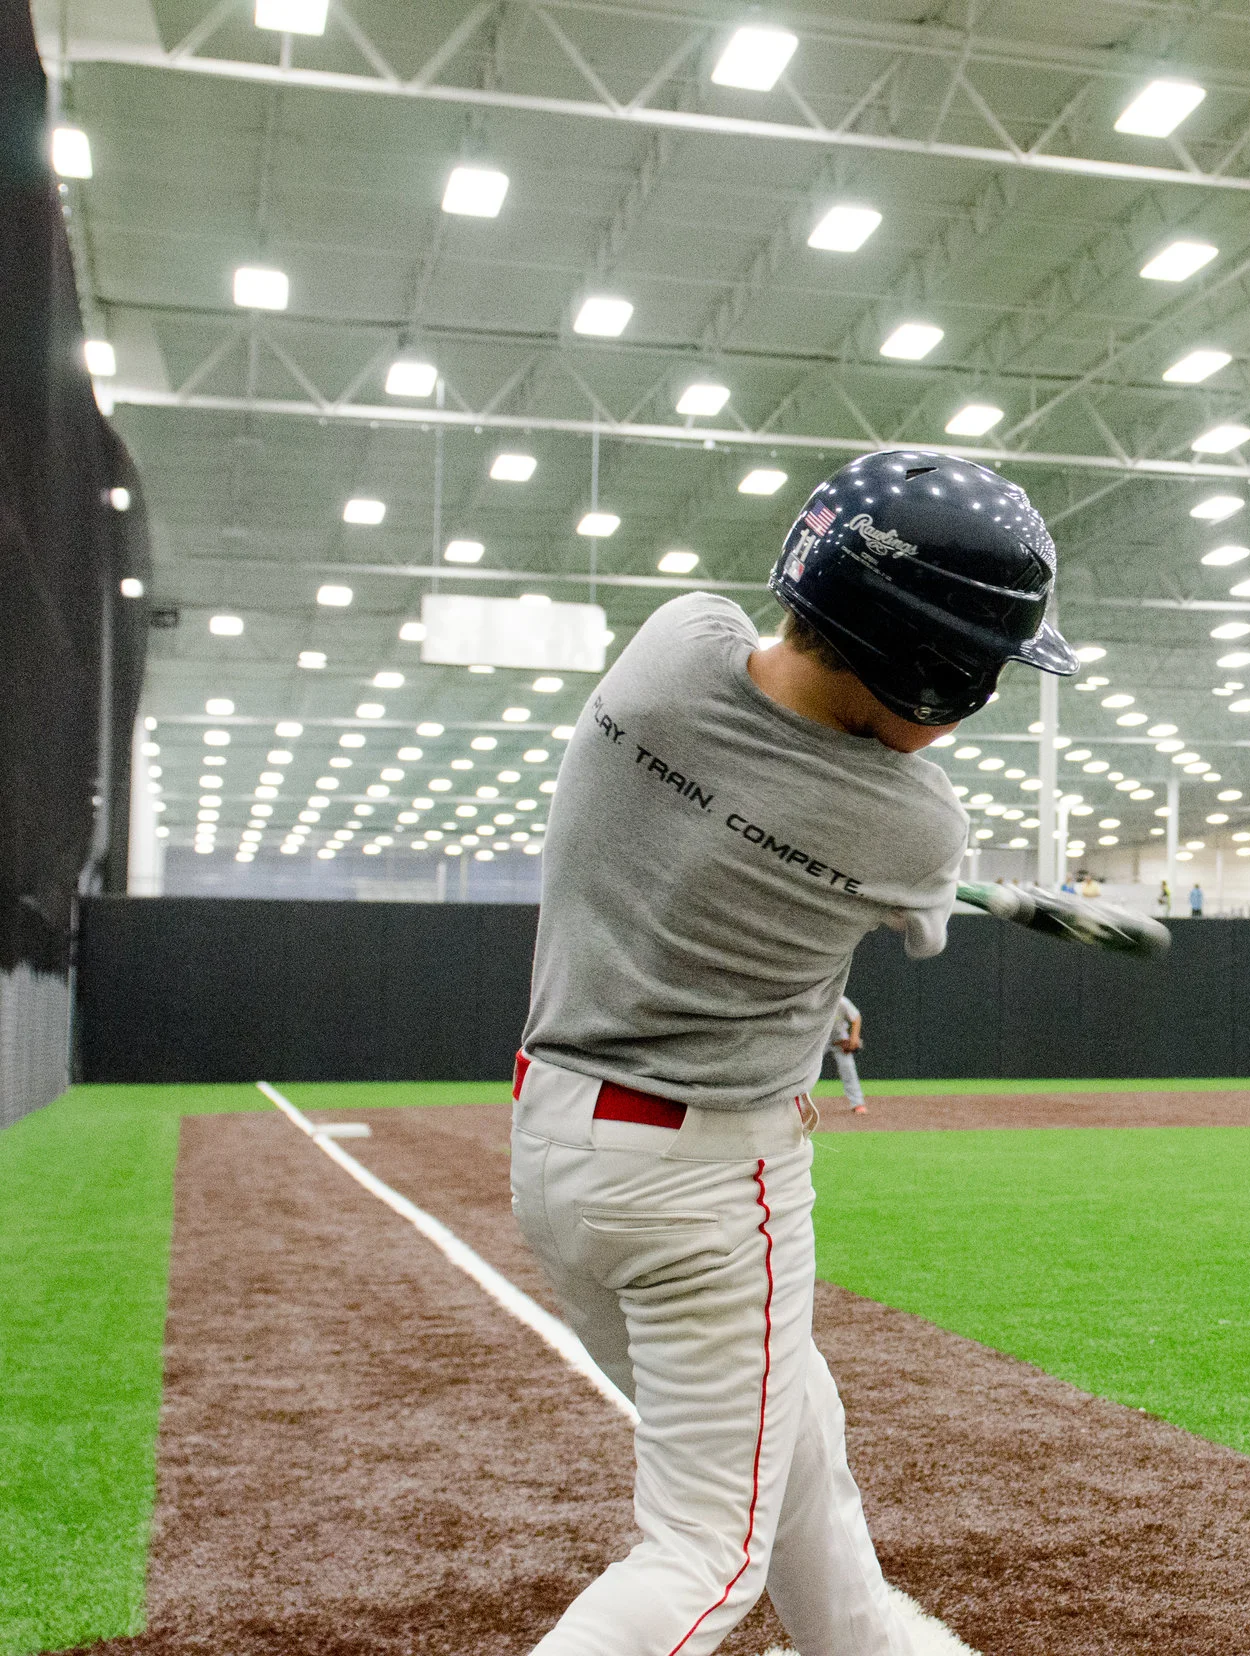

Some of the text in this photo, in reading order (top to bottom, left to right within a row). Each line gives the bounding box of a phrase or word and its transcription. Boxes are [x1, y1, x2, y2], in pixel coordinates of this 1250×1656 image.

[849, 513, 919, 559] Rawlings
[636, 744, 714, 813] TRAIN.
[726, 813, 864, 896] COMPETE.
